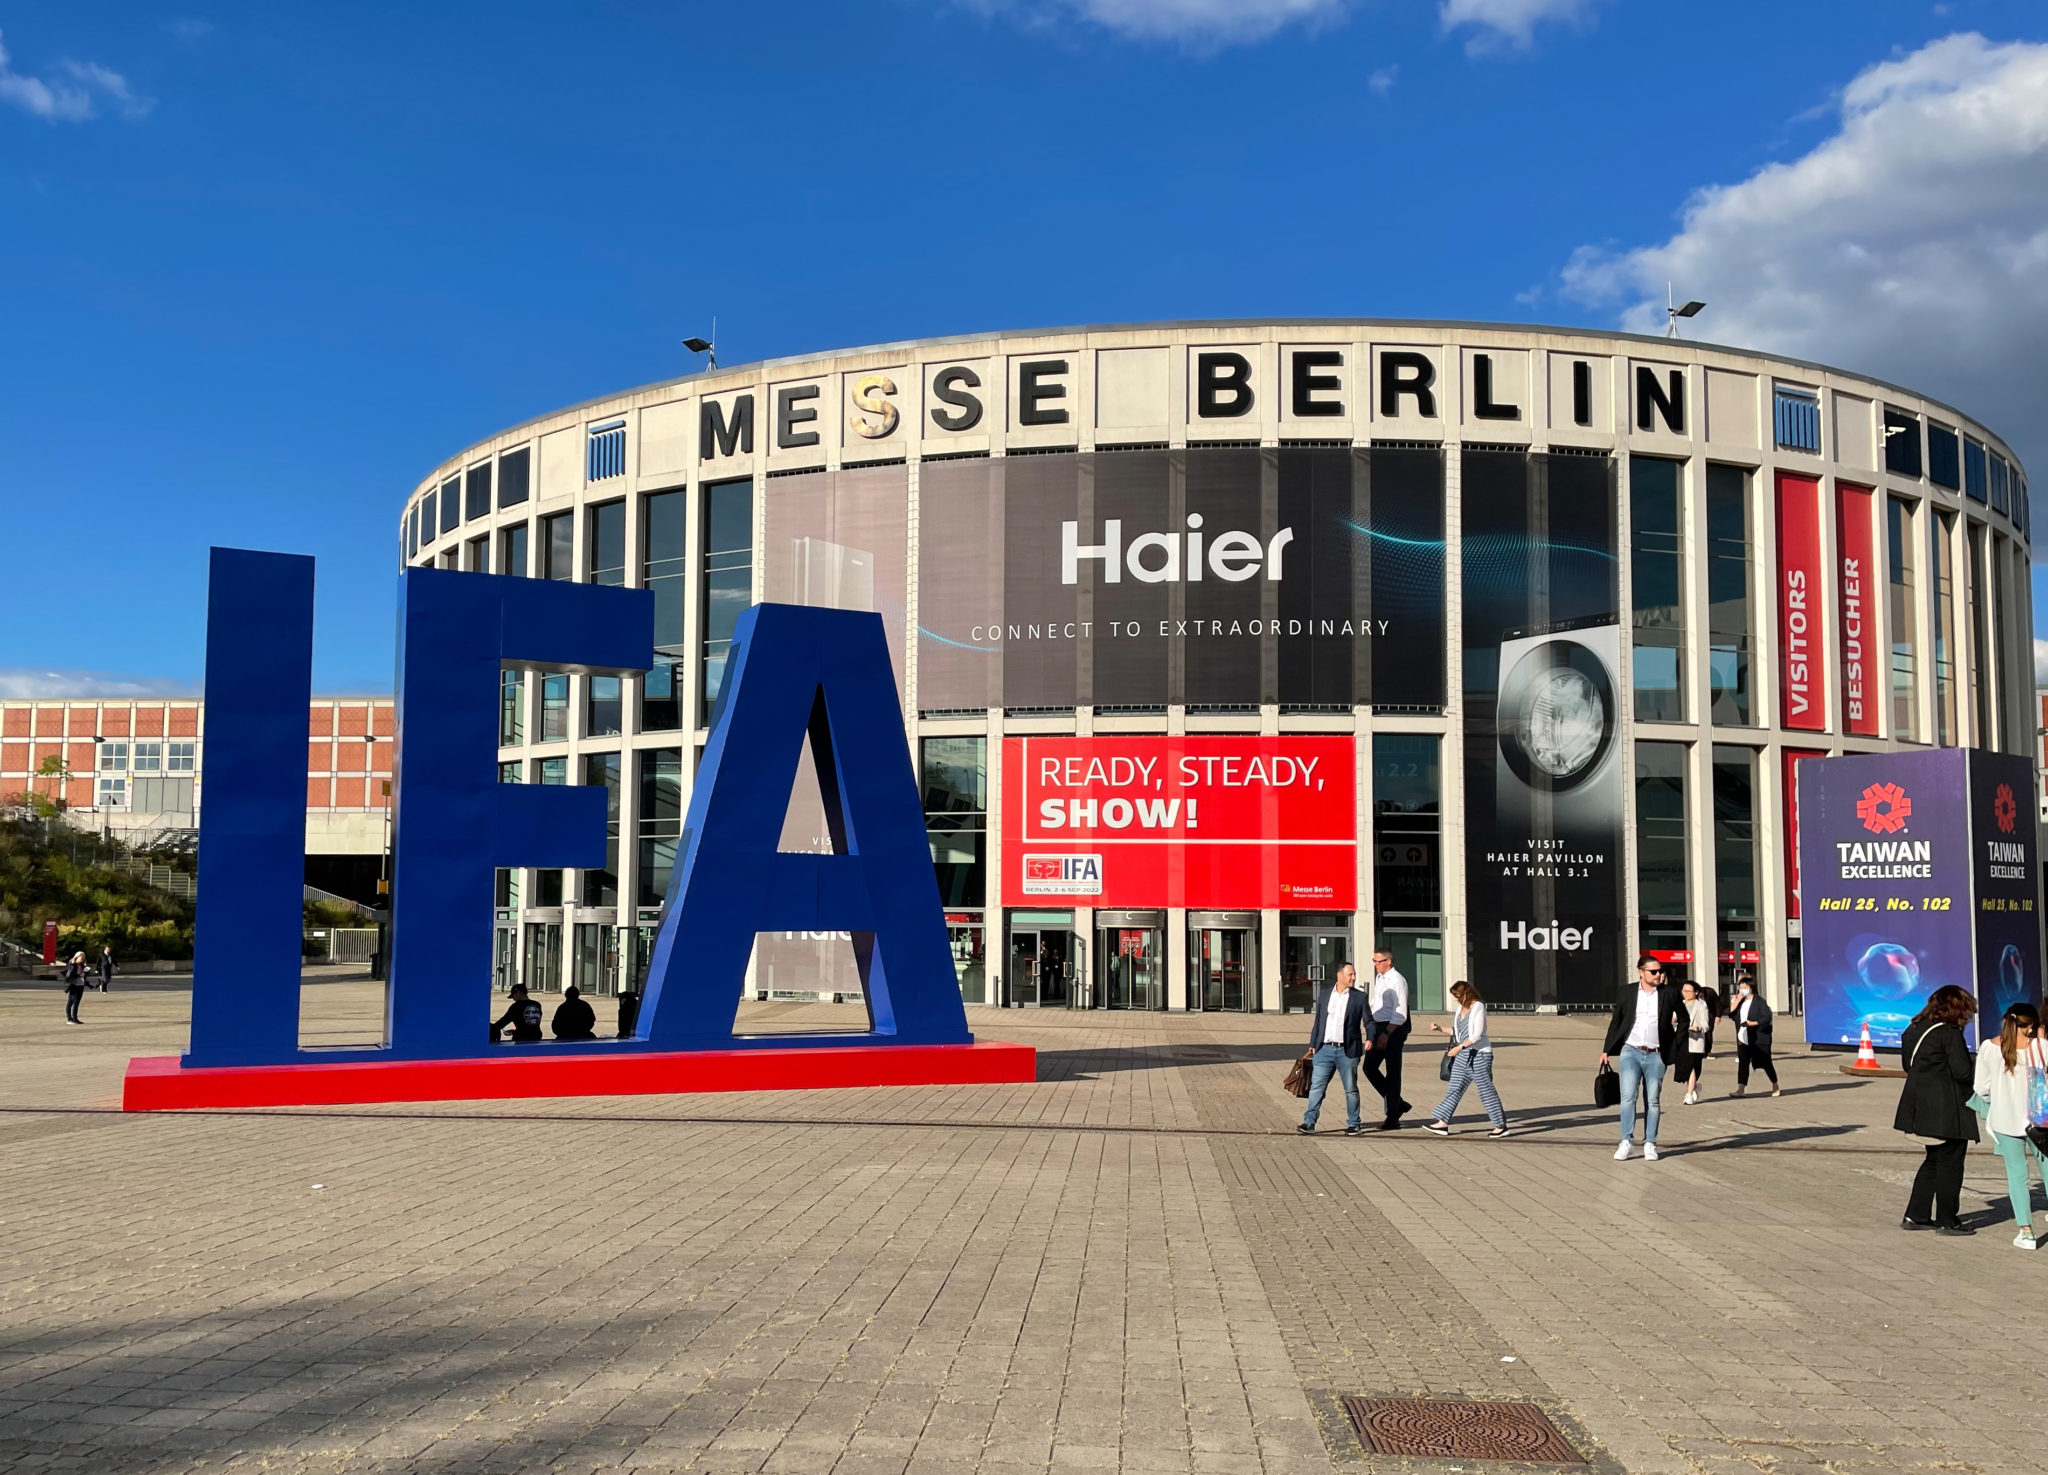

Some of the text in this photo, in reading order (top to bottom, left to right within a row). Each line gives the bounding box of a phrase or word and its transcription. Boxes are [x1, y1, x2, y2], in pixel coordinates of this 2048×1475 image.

[700, 350, 1684, 461] MESSE BERLIN
[1061, 512, 1294, 585] Haier
[970, 619, 1391, 642] CONNECT TO EXTRAORDINARY
[1788, 569, 1809, 715] VISITORS
[1843, 557, 1863, 721] BESUCHER
[1040, 756, 1325, 791] READY, STEADY,
[184, 546, 974, 1068] IFA
[1040, 797, 1199, 829] SHOW!
[812, 837, 832, 846] VIS
[1527, 839, 1565, 850] VISIT
[1836, 840, 1931, 863] TAIWAN
[1987, 840, 2025, 863] TAIWAN
[1064, 858, 1099, 880] IFA
[1486, 853, 1605, 864] HAIER PAVILLON
[1502, 867, 1589, 878] AT HALL 3.1
[1841, 864, 1932, 879] EXCELLENCE
[1990, 864, 2026, 880] EXCELLENCE
[1292, 885, 1333, 893] Messe Berlin
[1819, 897, 1952, 912] Hall 25, No. 102
[1981, 898, 1996, 911] Hall
[2009, 898, 2020, 912] No.
[2022, 899, 2033, 912] 102
[1500, 919, 1594, 951] Haier
